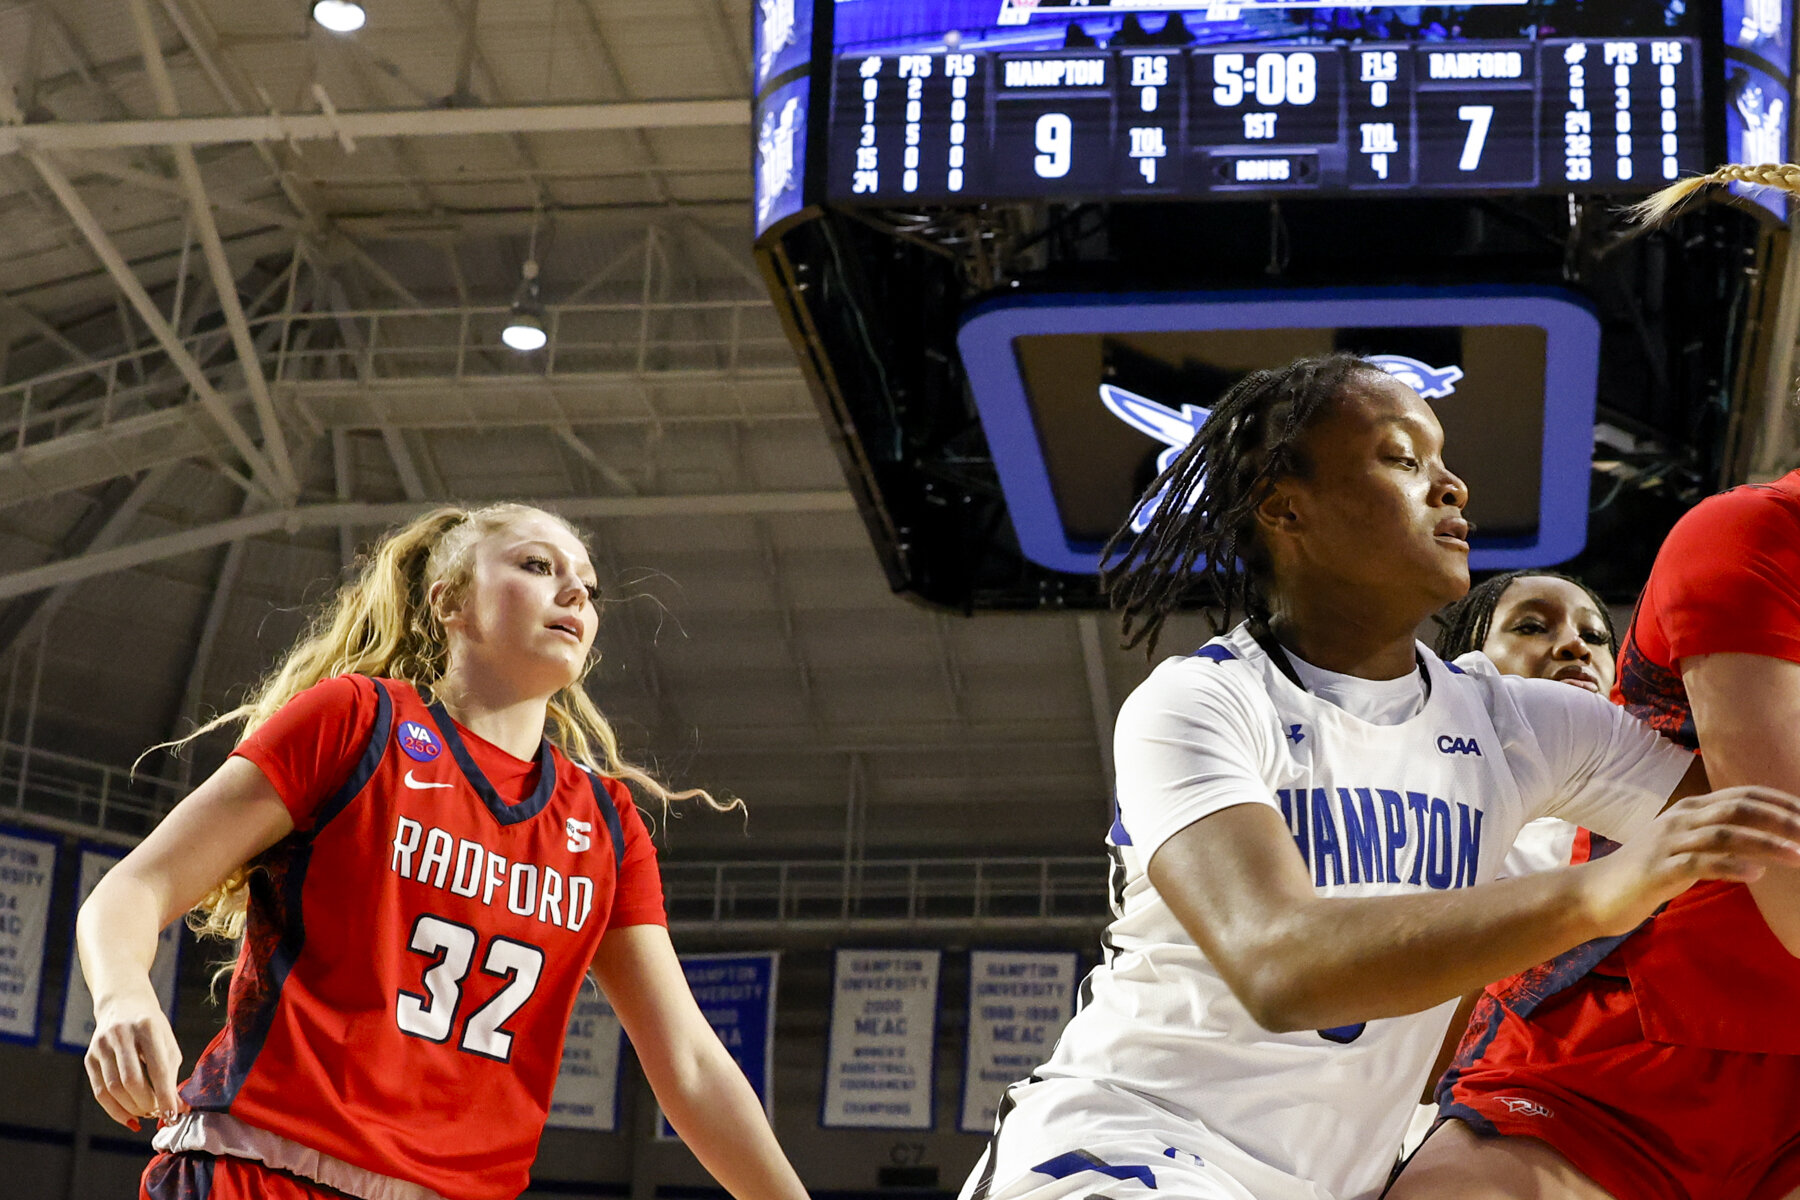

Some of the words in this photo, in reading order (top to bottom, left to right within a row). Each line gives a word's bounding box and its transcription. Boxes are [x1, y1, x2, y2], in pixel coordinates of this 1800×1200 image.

[899, 55, 932, 78] PTS
[945, 54, 976, 77] FLS
[1361, 51, 1398, 79] FLS
[1429, 52, 1522, 79] RADFORD
[1604, 42, 1639, 65] PTS
[1651, 41, 1682, 65] FLS
[1004, 59, 1105, 87] HAMPTON
[1131, 56, 1168, 84] FLS
[1213, 52, 1317, 107] 5:08
[1569, 64, 1585, 88] 2
[863, 78, 878, 100] 0
[907, 77, 922, 100] 2
[1140, 86, 1158, 112] 0
[1371, 81, 1388, 107] 0
[1614, 87, 1630, 110] 3
[864, 101, 875, 123] 1
[860, 124, 875, 146] 3
[905, 123, 920, 145] 5
[1243, 112, 1278, 139] 1ST
[1360, 123, 1398, 151] TOL
[1458, 105, 1494, 171] 7
[1034, 112, 1073, 178] 9
[1129, 127, 1166, 155] TOL
[856, 147, 878, 169] 15
[1139, 158, 1156, 184] 4
[1236, 159, 1290, 181] BONUS
[1371, 153, 1388, 180] 4
[407, 722, 432, 743] VA
[1437, 735, 1482, 756] CAA
[405, 736, 438, 757] 250
[1276, 787, 1484, 890] HAMPTON
[391, 815, 594, 932] RADFORD
[396, 912, 545, 1064] 32
